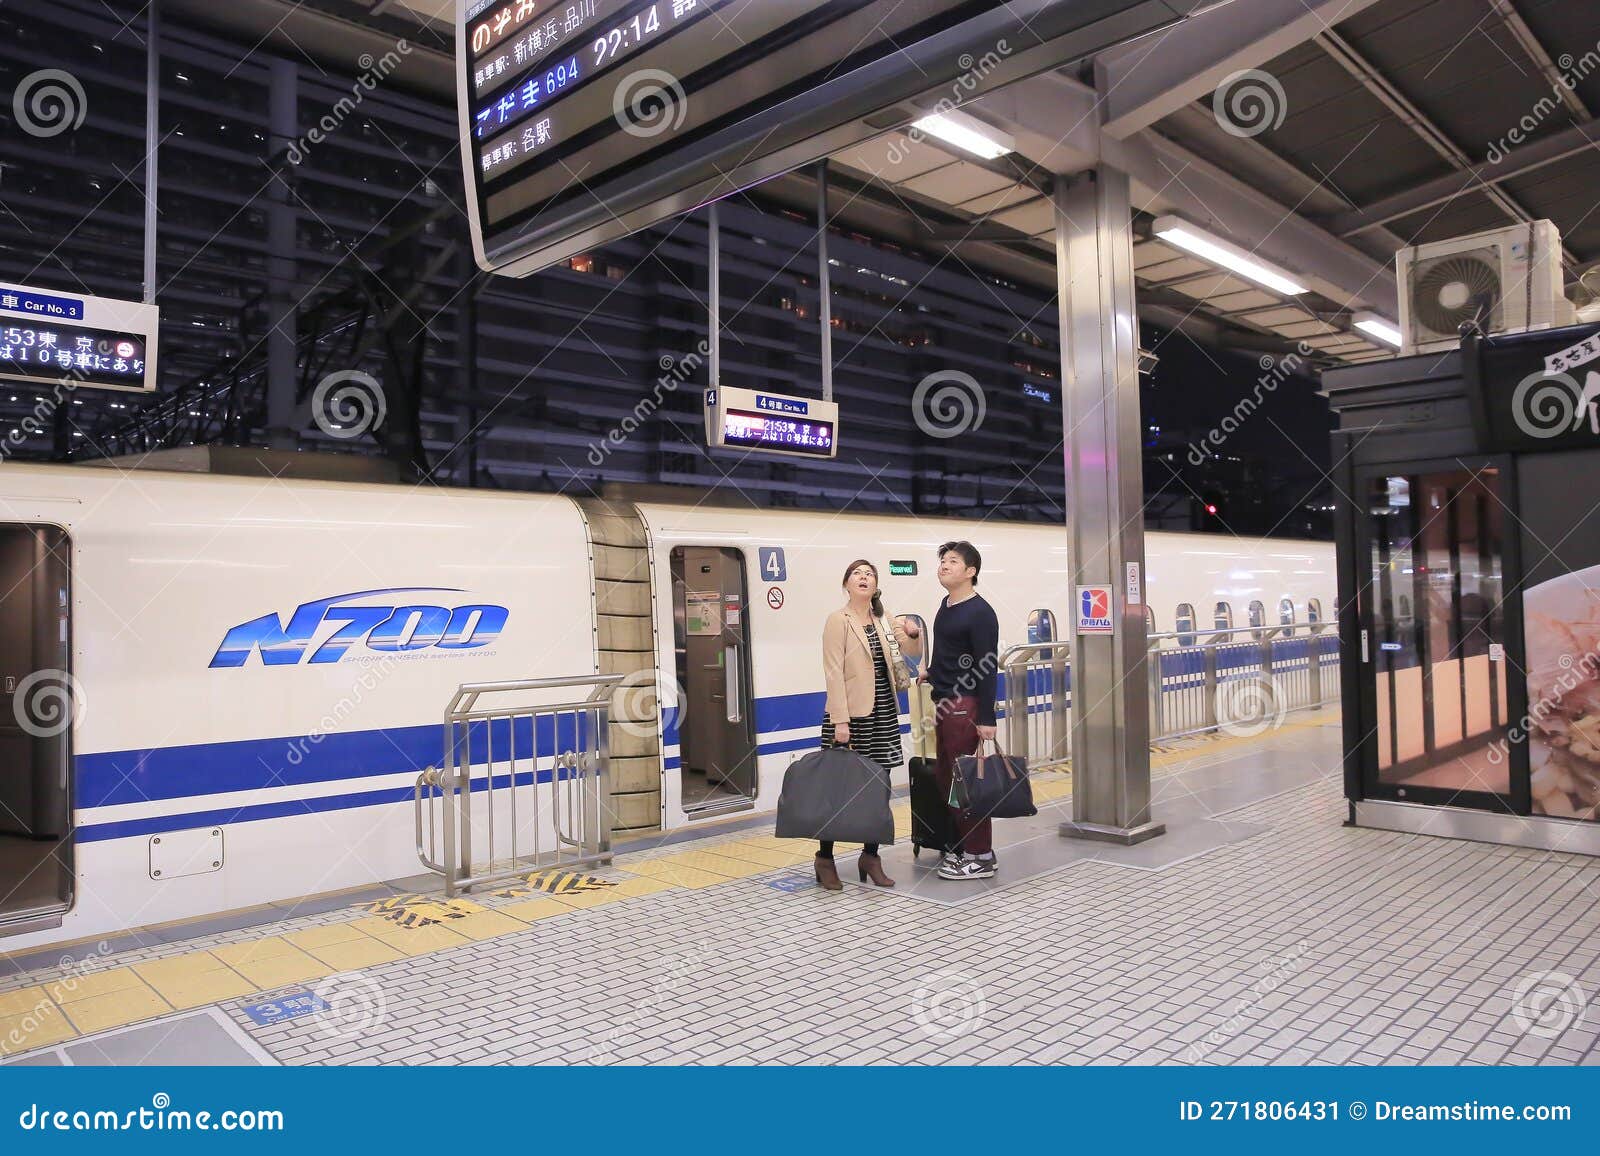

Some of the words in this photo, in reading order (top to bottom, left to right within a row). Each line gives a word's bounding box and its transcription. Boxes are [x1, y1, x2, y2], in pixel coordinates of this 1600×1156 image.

[546, 56, 579, 94] 694
[594, 5, 660, 66] 22:14
[521, 117, 551, 153] 各駅
[24, 300, 45, 311] Car
[47, 303, 66, 315] No.
[69, 307, 76, 316] 3
[708, 392, 716, 405] 4
[766, 551, 780, 577] 4
[207, 588, 510, 669] N700
